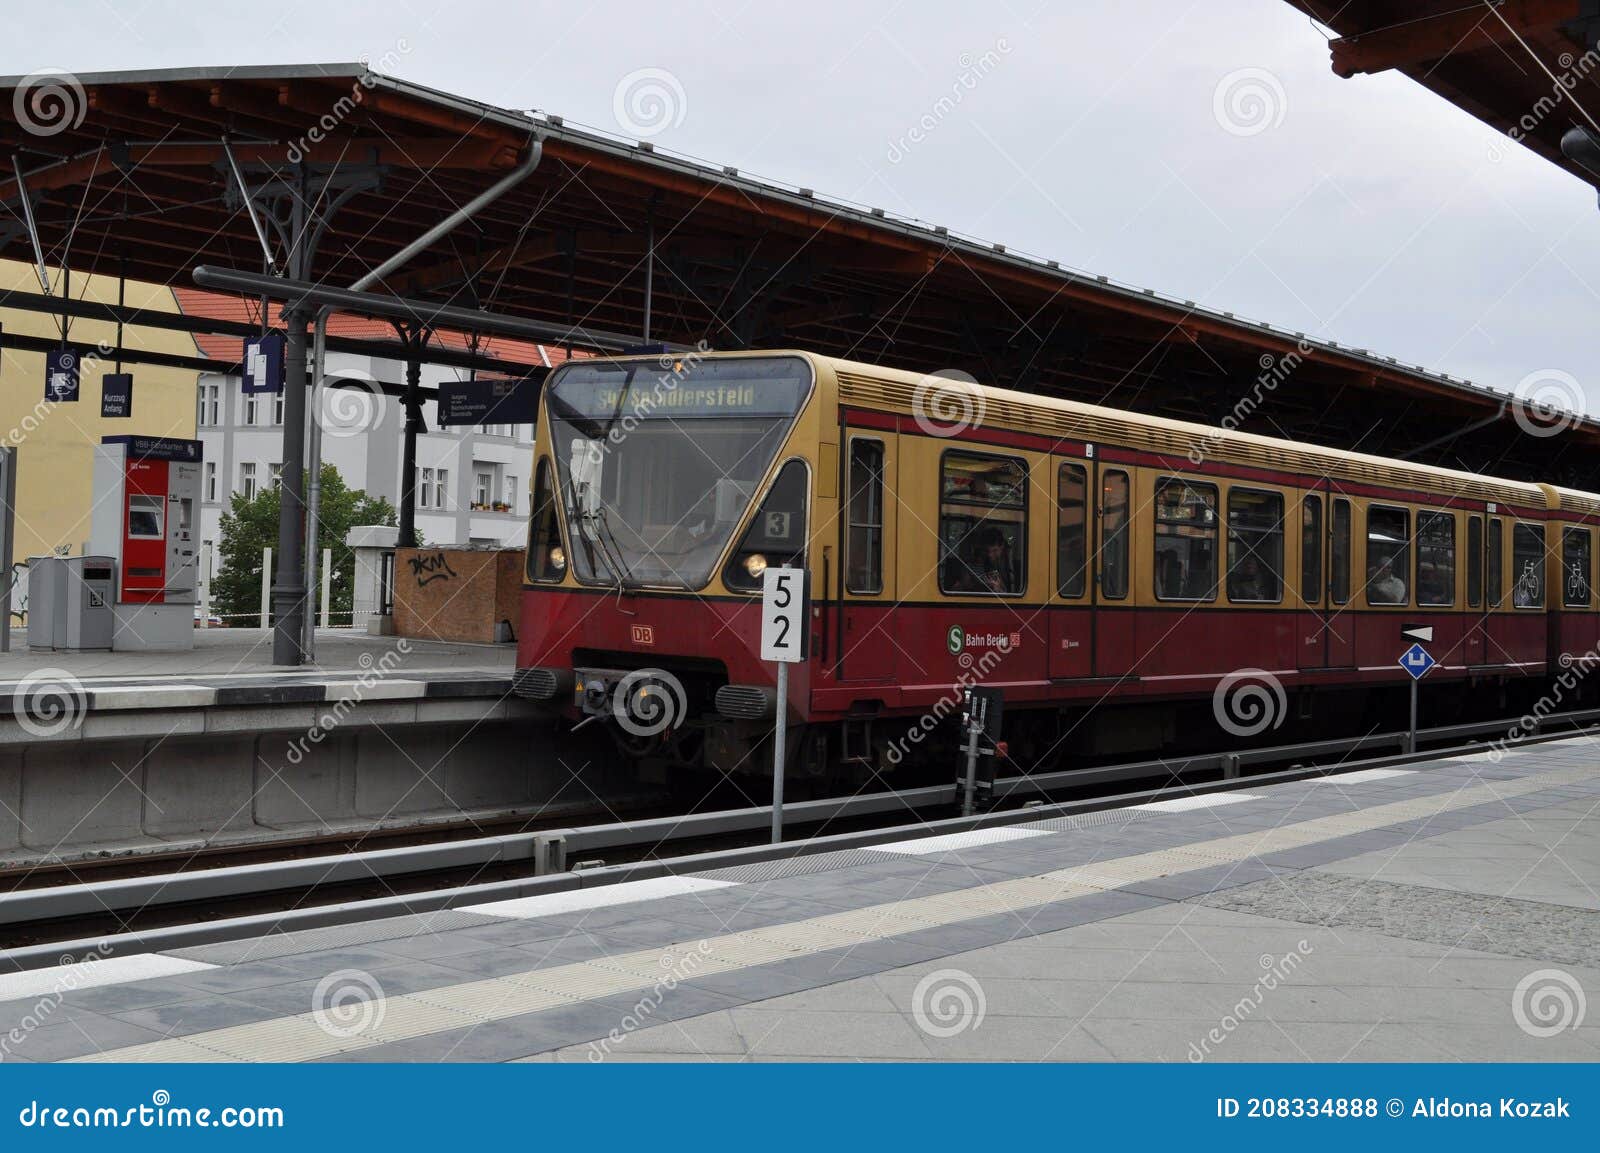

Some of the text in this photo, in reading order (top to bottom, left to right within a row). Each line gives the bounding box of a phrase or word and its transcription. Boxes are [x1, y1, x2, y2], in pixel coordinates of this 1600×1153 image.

[770, 512, 785, 536] 3
[774, 575, 791, 608] 5
[632, 626, 653, 644] DB
[773, 615, 790, 648] 2
[965, 633, 985, 647] Bahn
